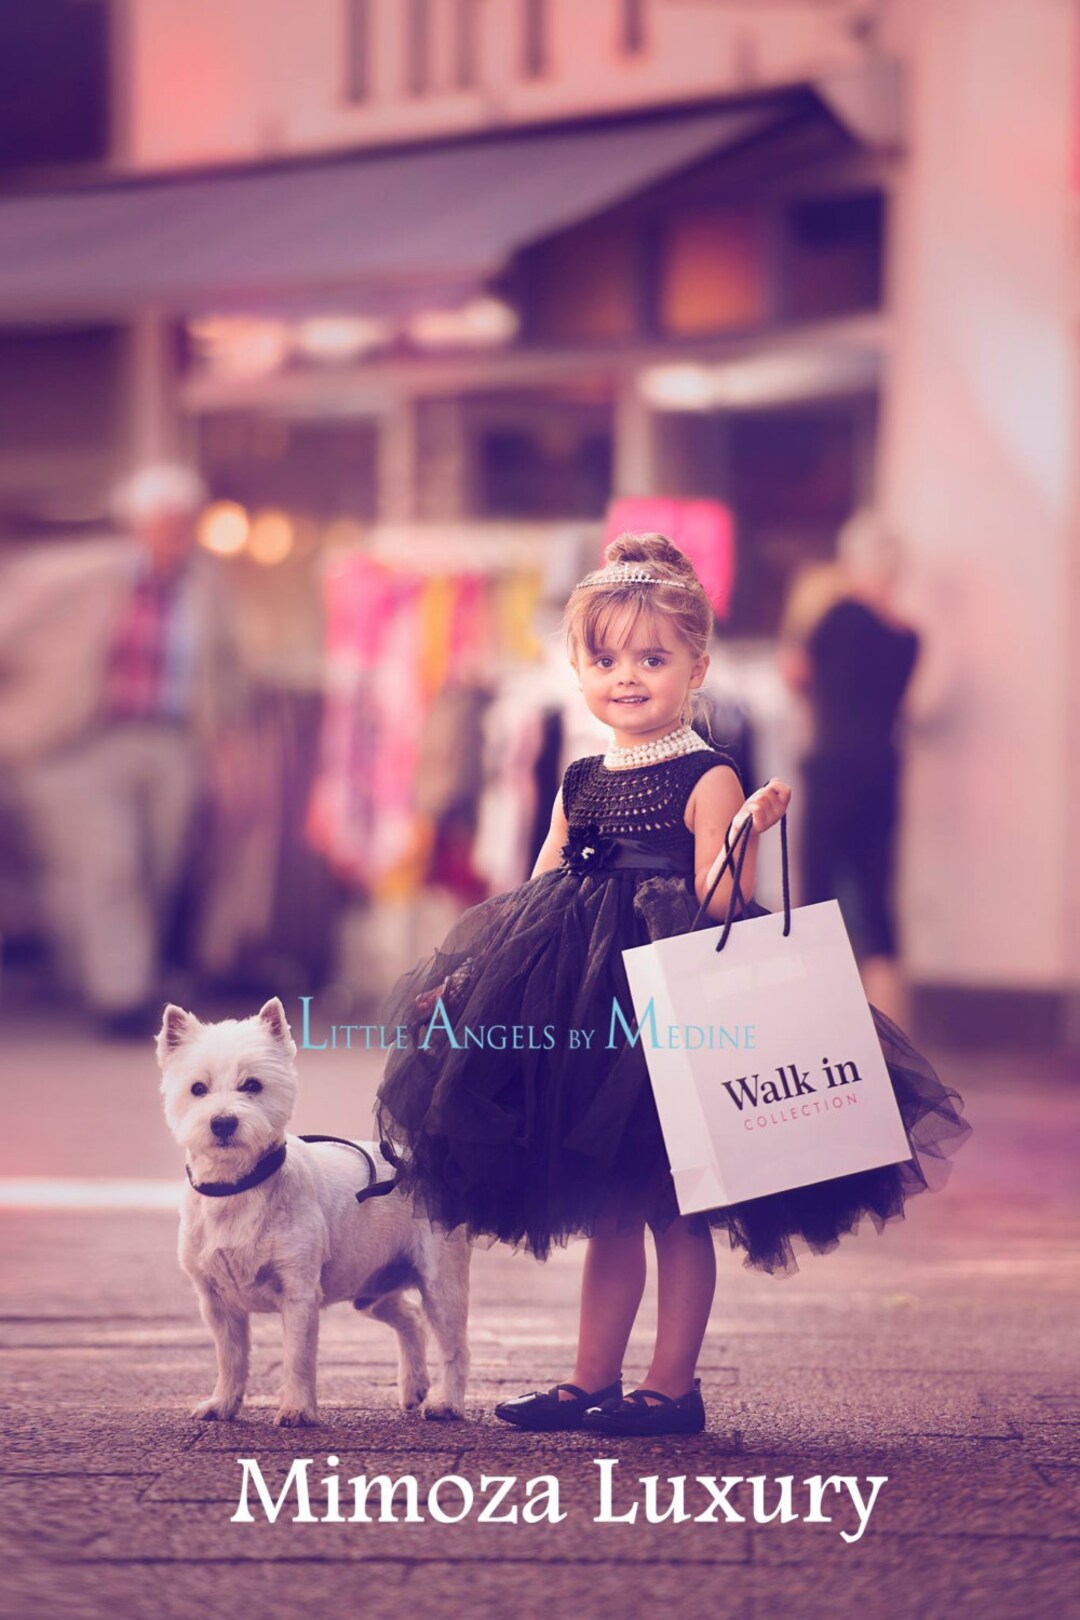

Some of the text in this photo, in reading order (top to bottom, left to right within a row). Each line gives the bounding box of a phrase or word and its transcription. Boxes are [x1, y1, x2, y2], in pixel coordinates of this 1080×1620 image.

[721, 1057, 863, 1112] Walk in
[743, 1093, 858, 1131] COLLECTION
